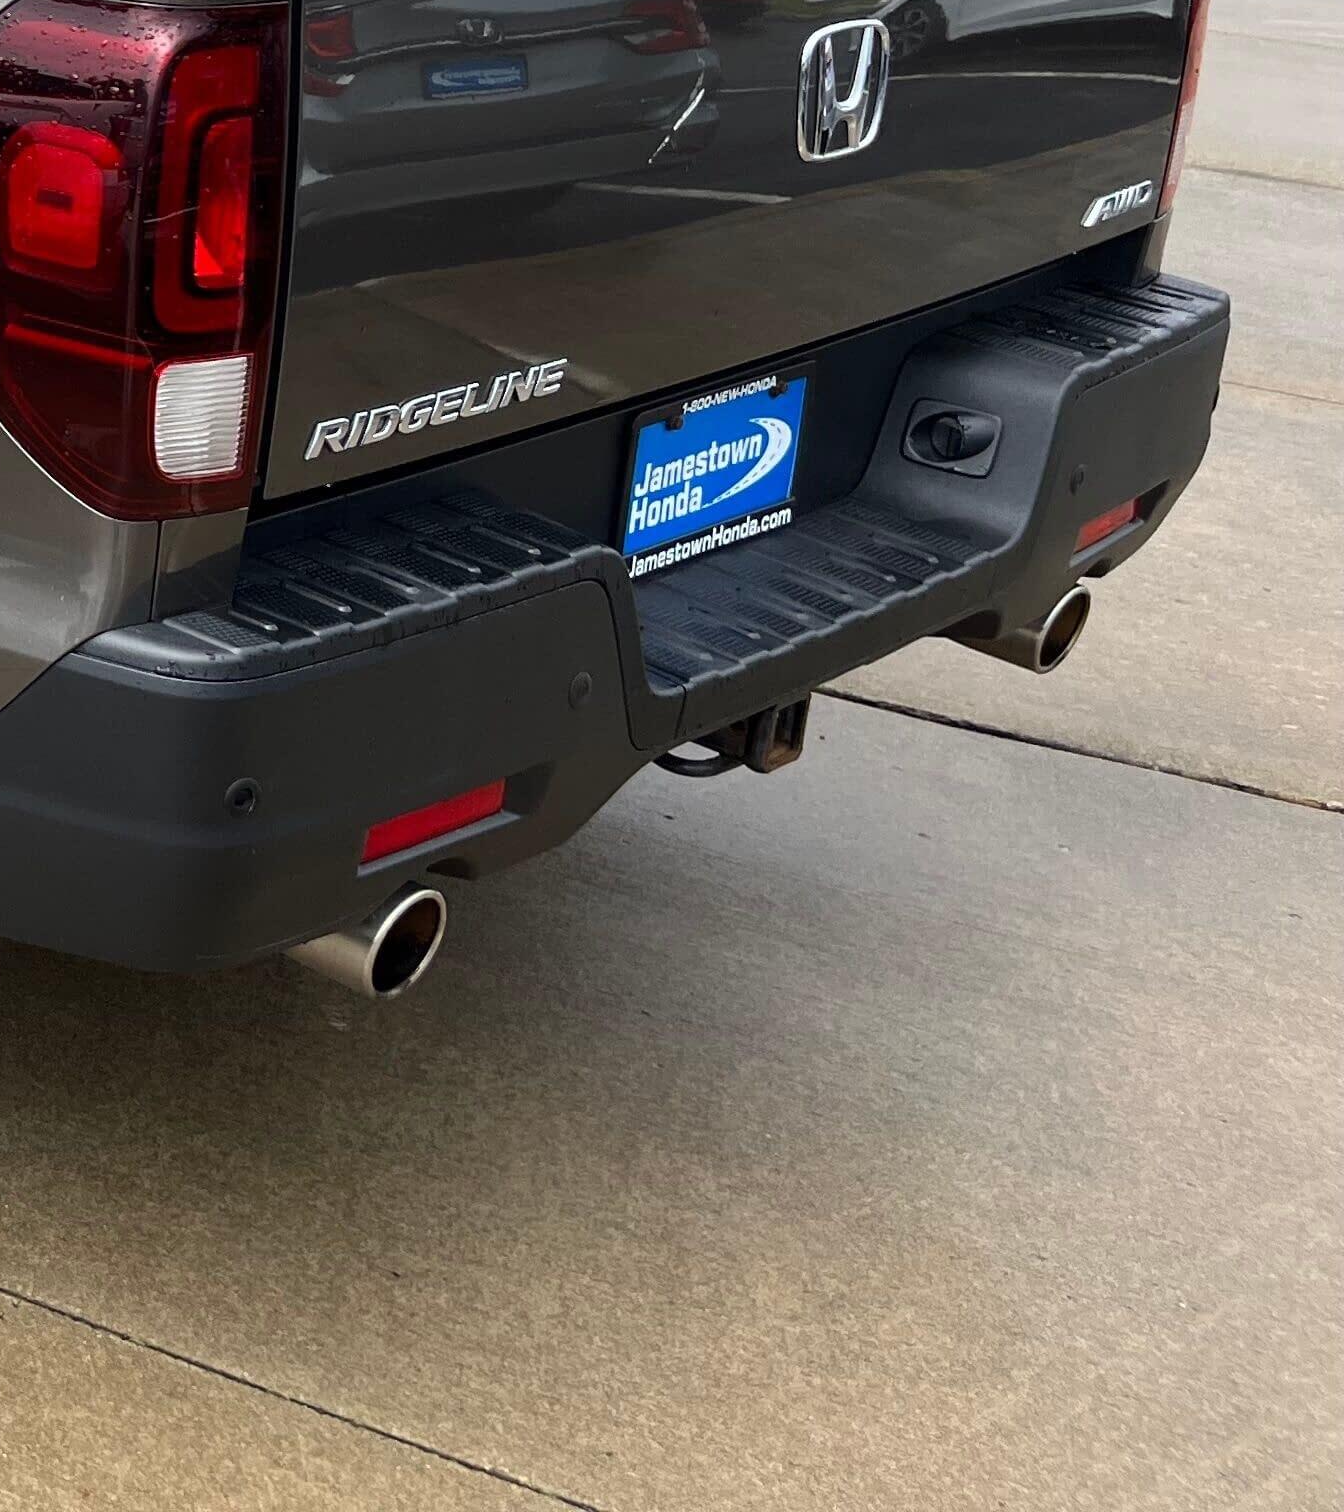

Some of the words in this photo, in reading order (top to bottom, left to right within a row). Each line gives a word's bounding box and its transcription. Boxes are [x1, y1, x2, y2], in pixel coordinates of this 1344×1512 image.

[1080, 179, 1153, 228] AWD
[304, 358, 568, 461] RIDGELINE
[682, 375, 778, 416] 1-800-NEW-HONDA
[633, 433, 763, 498] Jamestown
[628, 480, 703, 535] Honda
[628, 507, 792, 579] JamestownHonda.com
